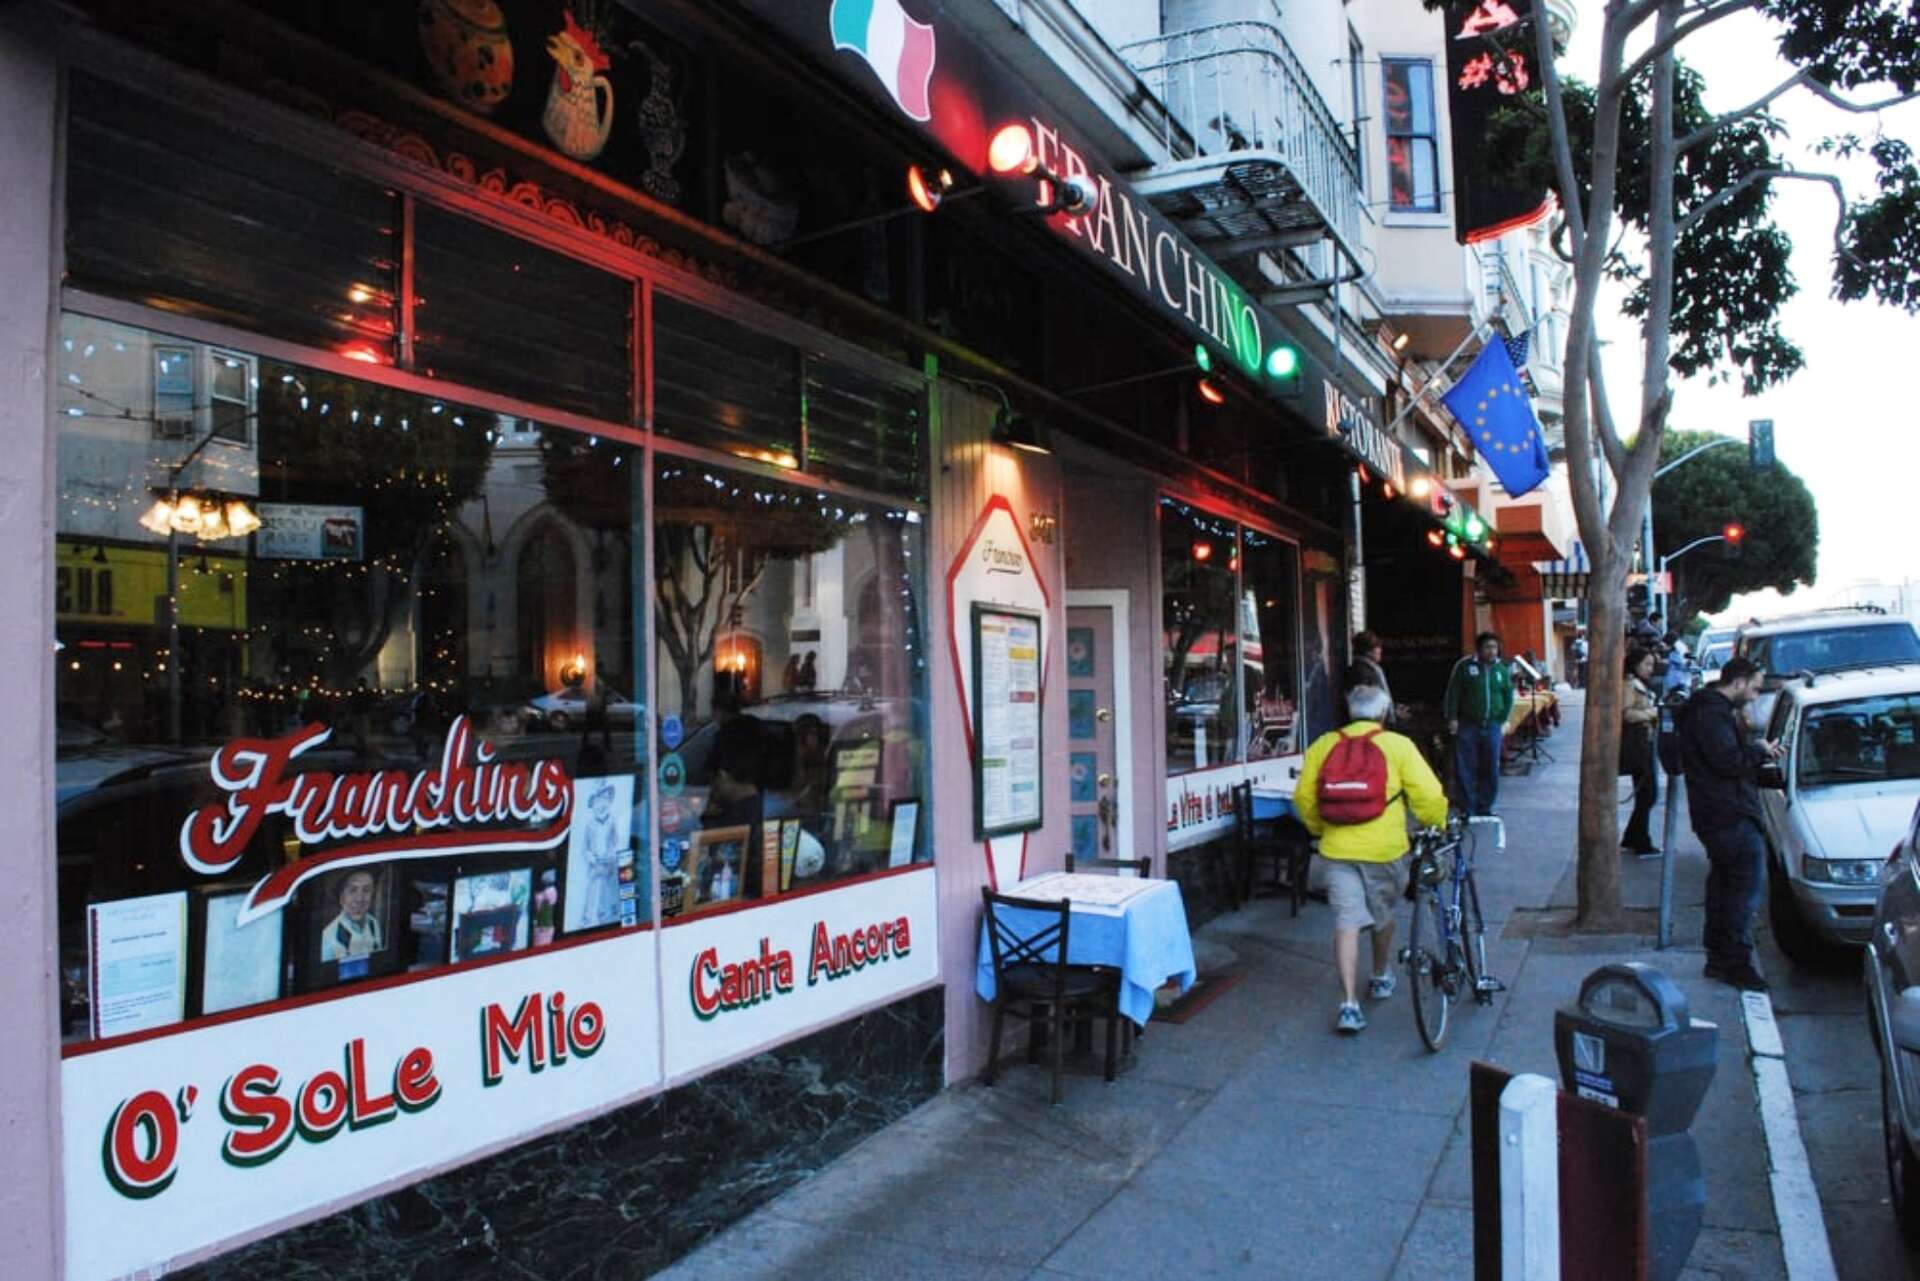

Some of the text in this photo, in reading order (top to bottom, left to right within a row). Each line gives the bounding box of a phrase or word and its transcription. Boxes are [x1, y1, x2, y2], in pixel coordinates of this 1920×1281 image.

[180, 714, 574, 874] Franchino
[690, 916, 911, 1021] Canta Ancora
[480, 990, 606, 1087] Mio
